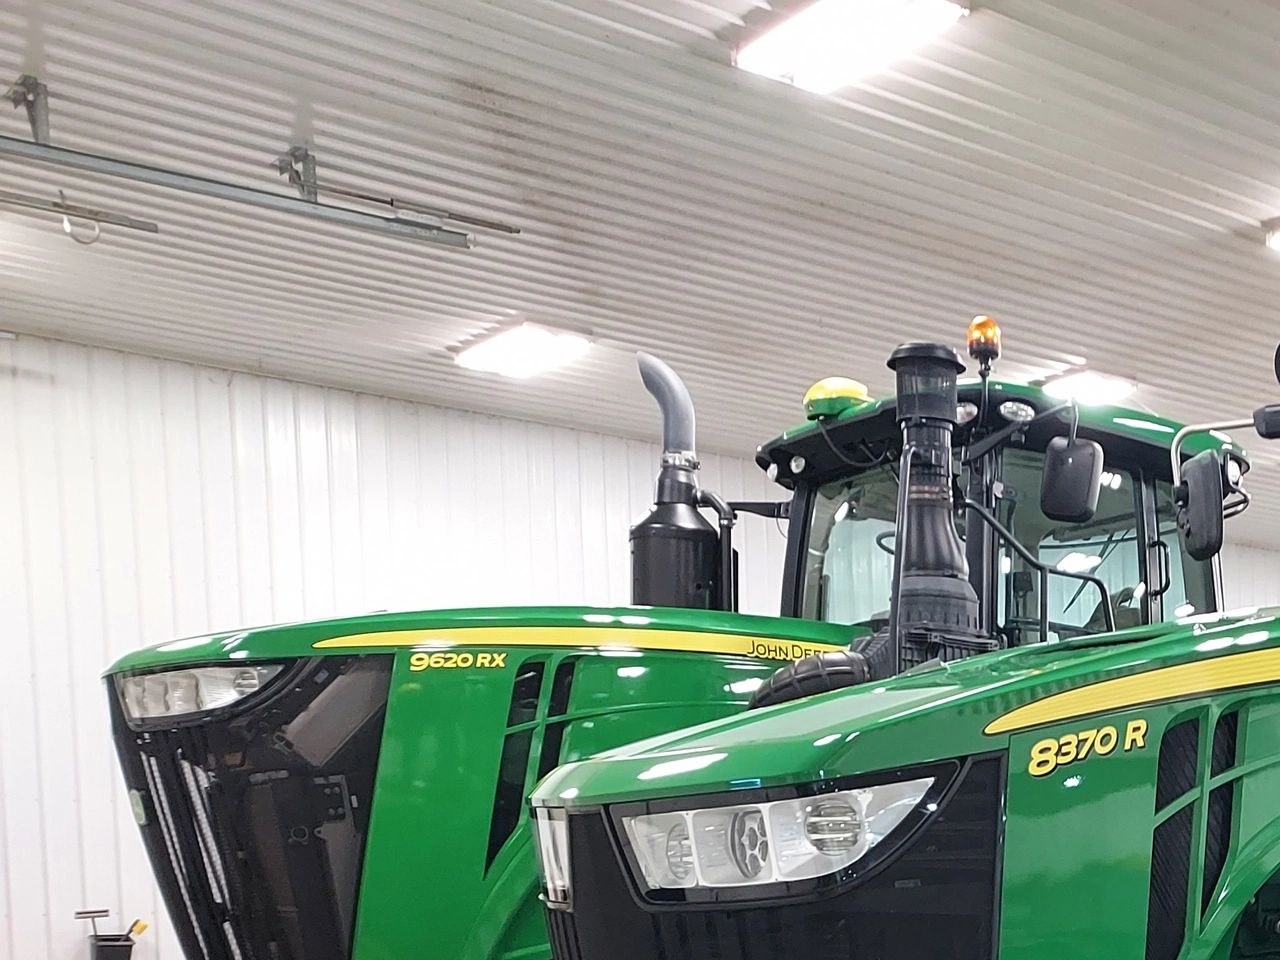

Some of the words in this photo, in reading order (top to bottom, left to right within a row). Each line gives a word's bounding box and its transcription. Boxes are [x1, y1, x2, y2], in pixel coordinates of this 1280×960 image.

[747, 640, 789, 659] JOHN
[409, 652, 474, 672] 9620
[475, 651, 508, 668] RX
[1028, 725, 1119, 776] 8370
[1123, 718, 1149, 751] R
